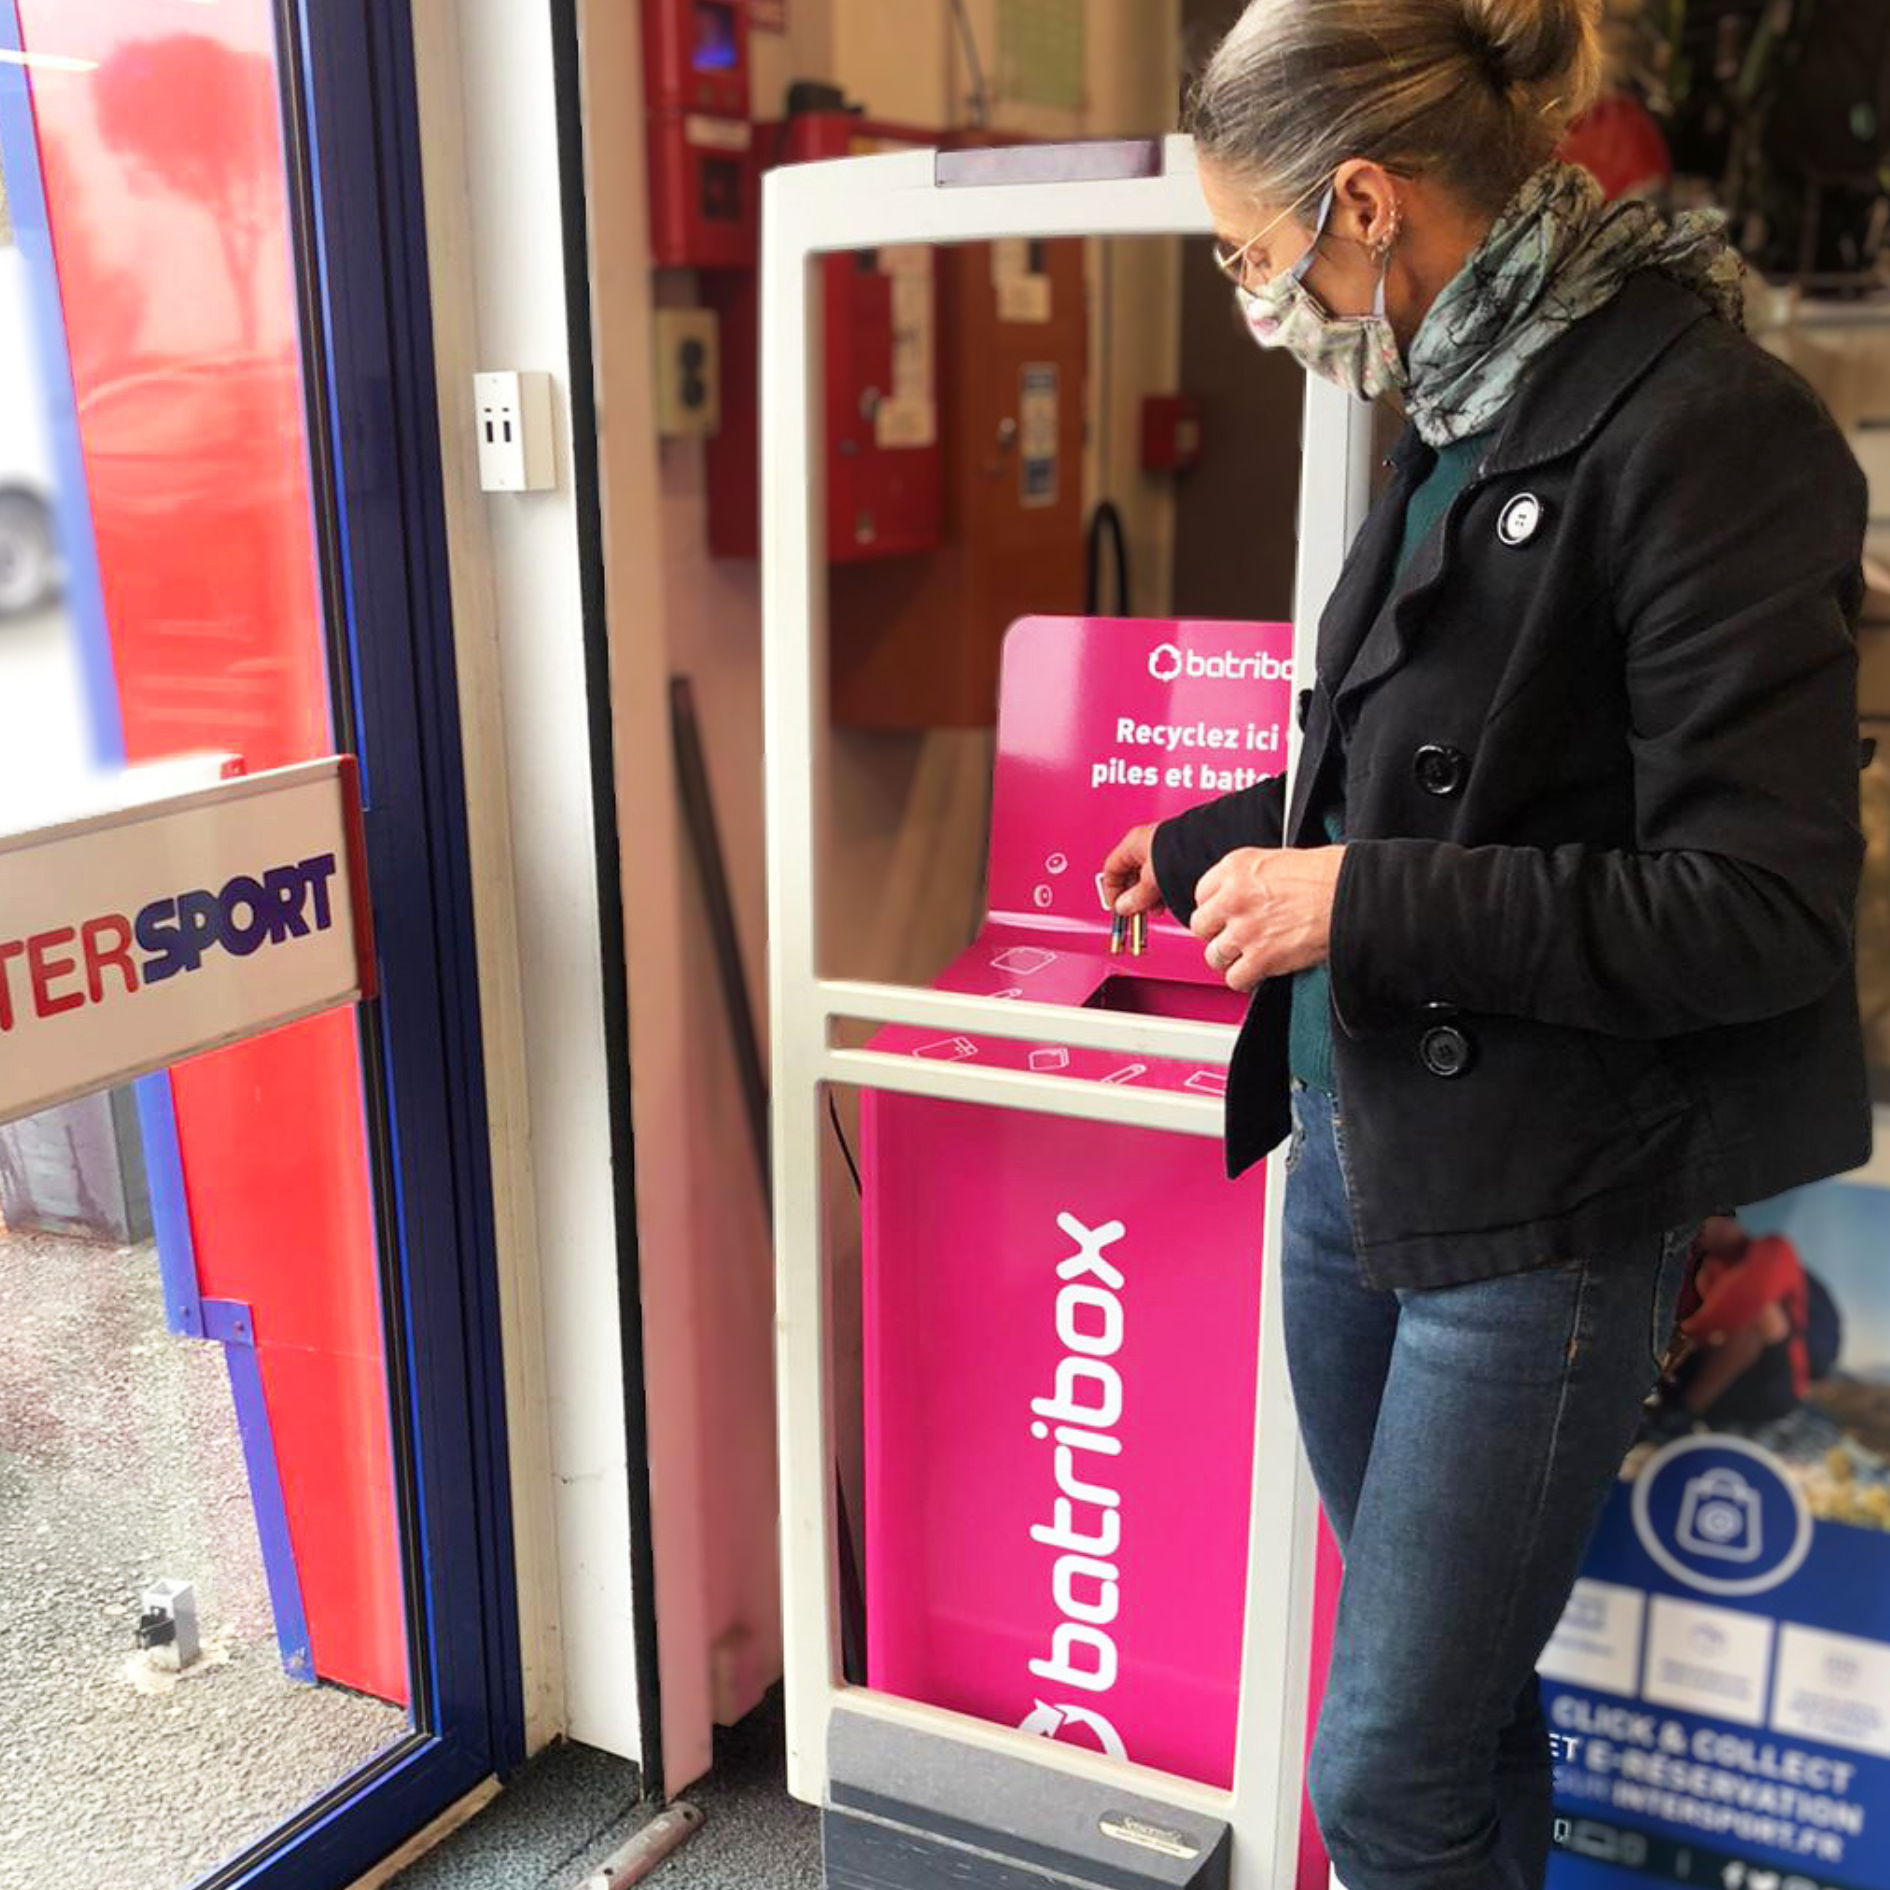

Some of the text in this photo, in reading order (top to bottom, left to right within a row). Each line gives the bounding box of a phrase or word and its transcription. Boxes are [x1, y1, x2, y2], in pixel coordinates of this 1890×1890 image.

[1116, 717, 1239, 750] Recyclez
[1246, 724, 1279, 751] ici
[1091, 757, 1278, 791] piles et batt
[1028, 1211, 1125, 1692] batribox
[1552, 1695, 1656, 1748] CLICK
[1691, 1728, 1857, 1794] COLLECT
